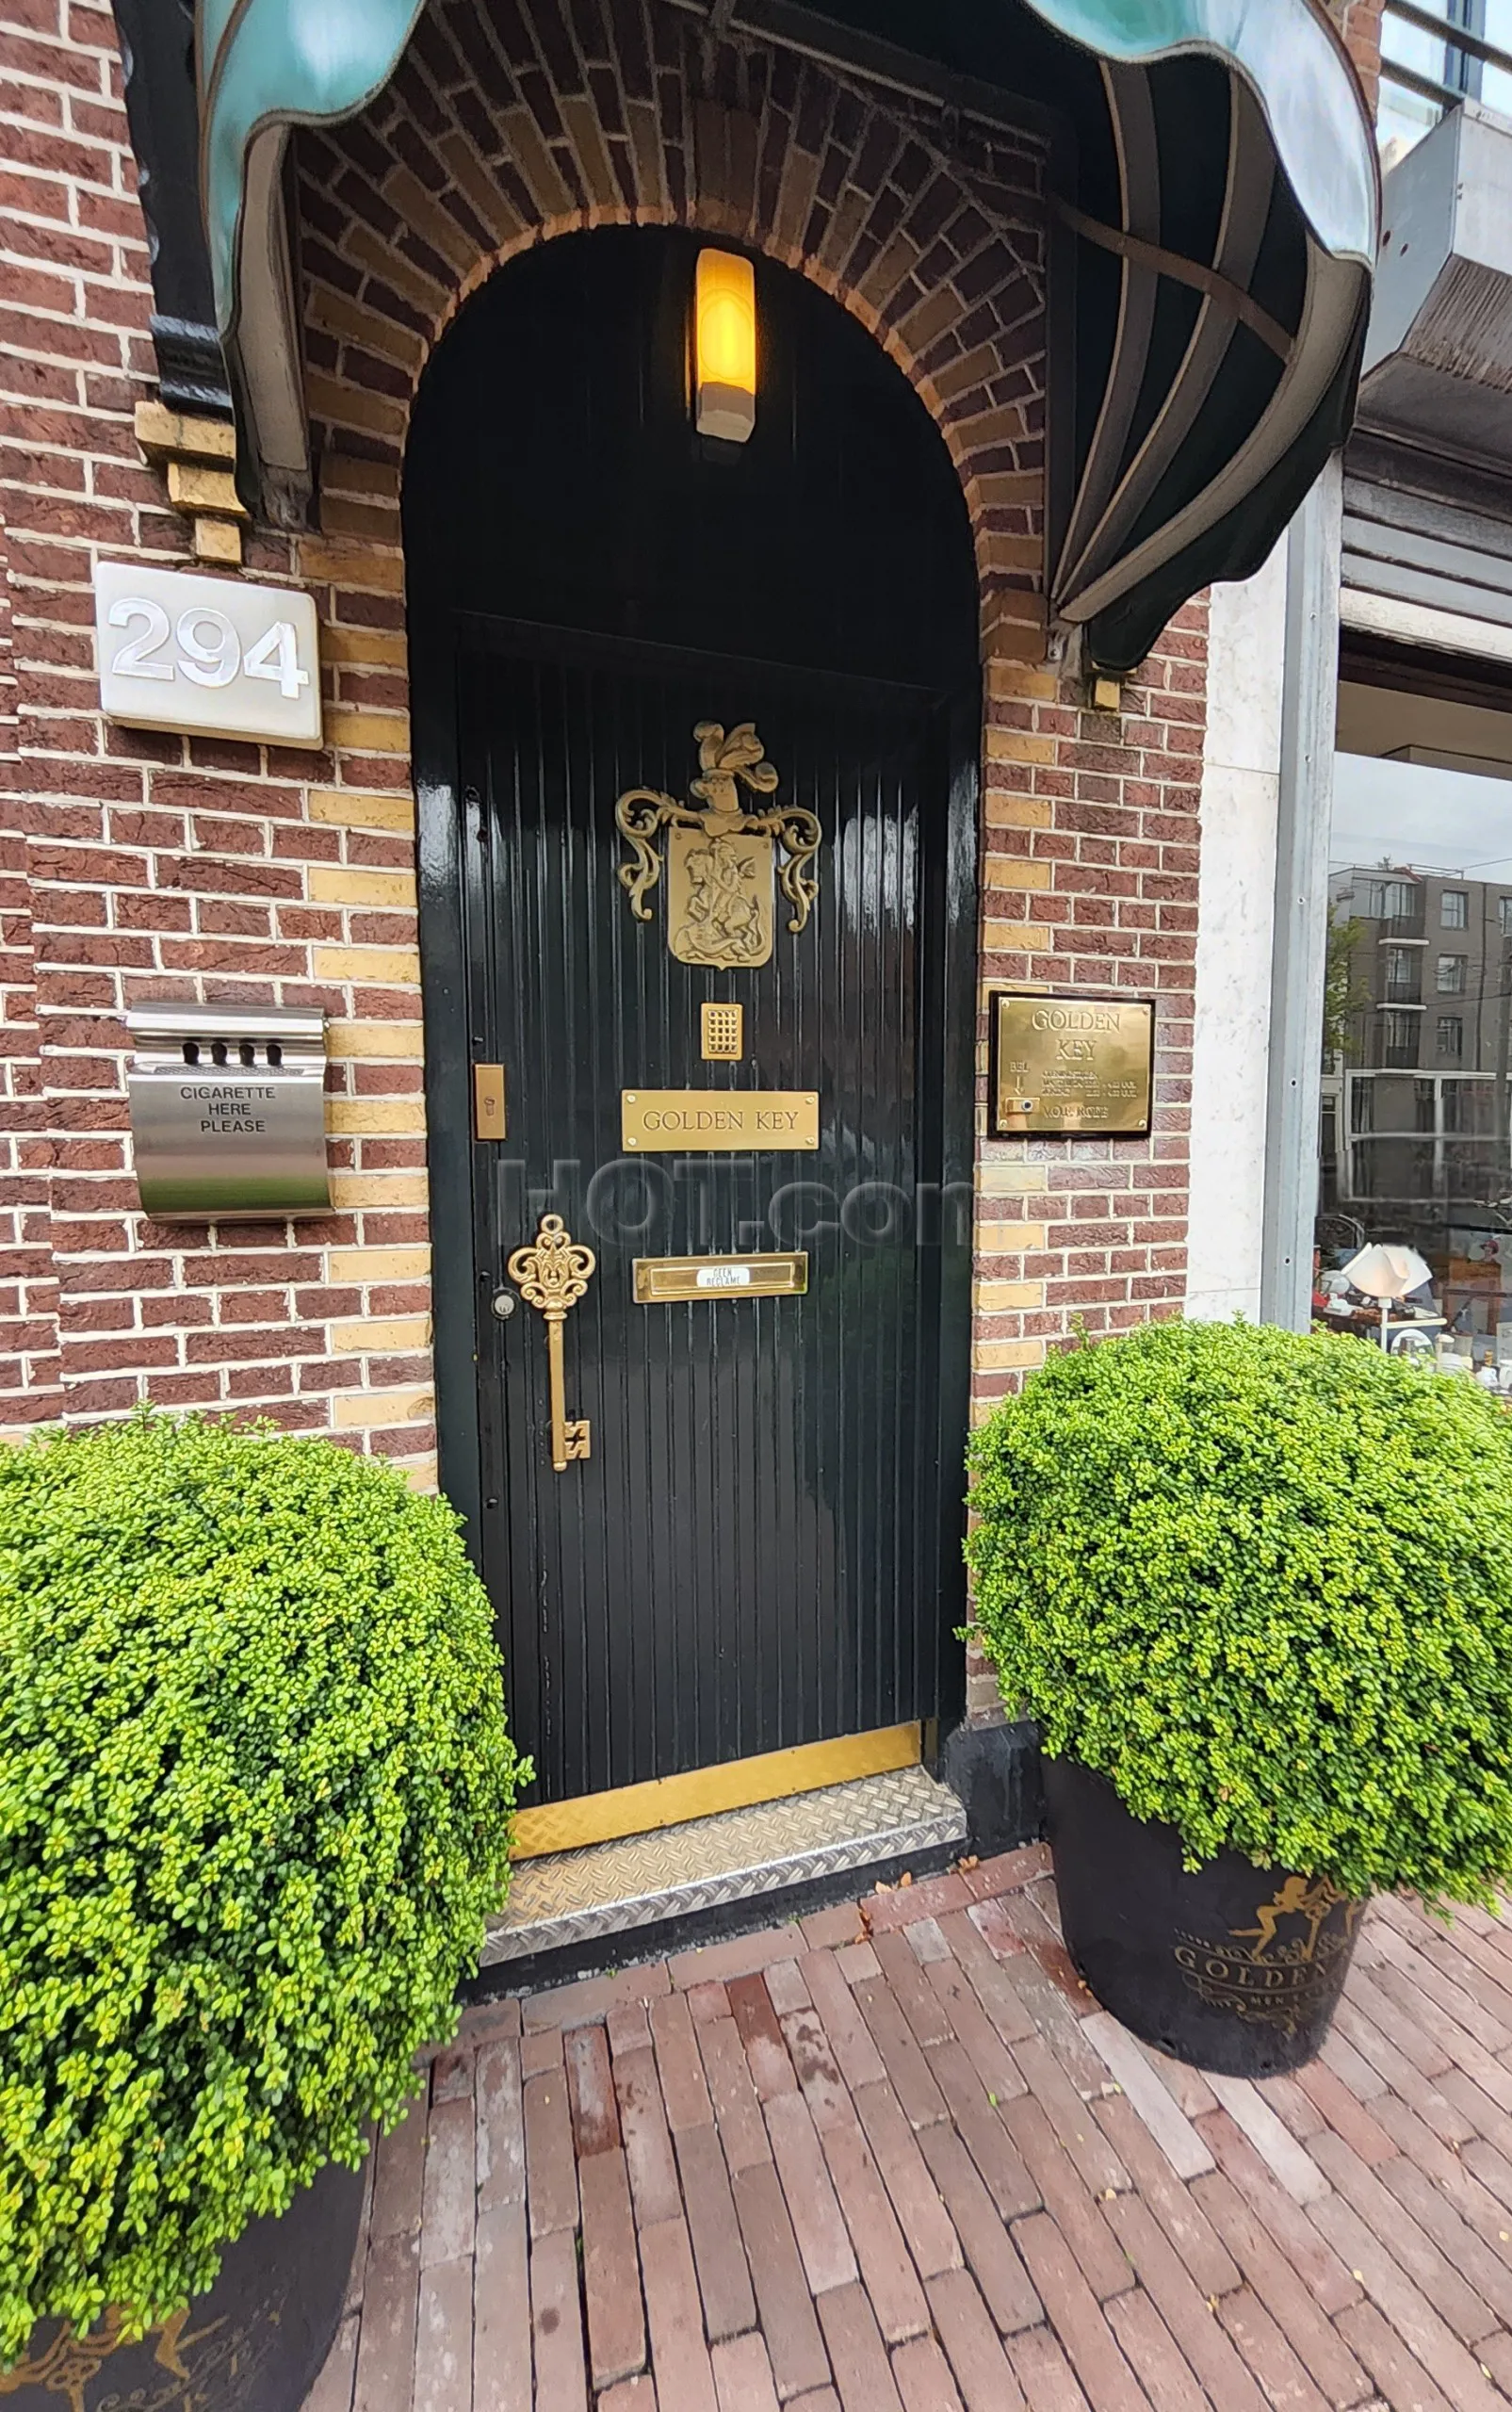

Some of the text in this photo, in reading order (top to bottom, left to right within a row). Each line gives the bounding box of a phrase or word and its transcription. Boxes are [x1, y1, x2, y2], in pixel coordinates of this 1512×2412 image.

[108, 596, 309, 699] 294
[1032, 1009, 1121, 1034] GOLDEN
[1055, 1038, 1097, 1061] KEY
[180, 1086, 276, 1100] CIGARETTE
[208, 1102, 252, 1116] HERE
[200, 1119, 266, 1133] PLEASE
[642, 1110, 800, 1131] GOLDEN KEY
